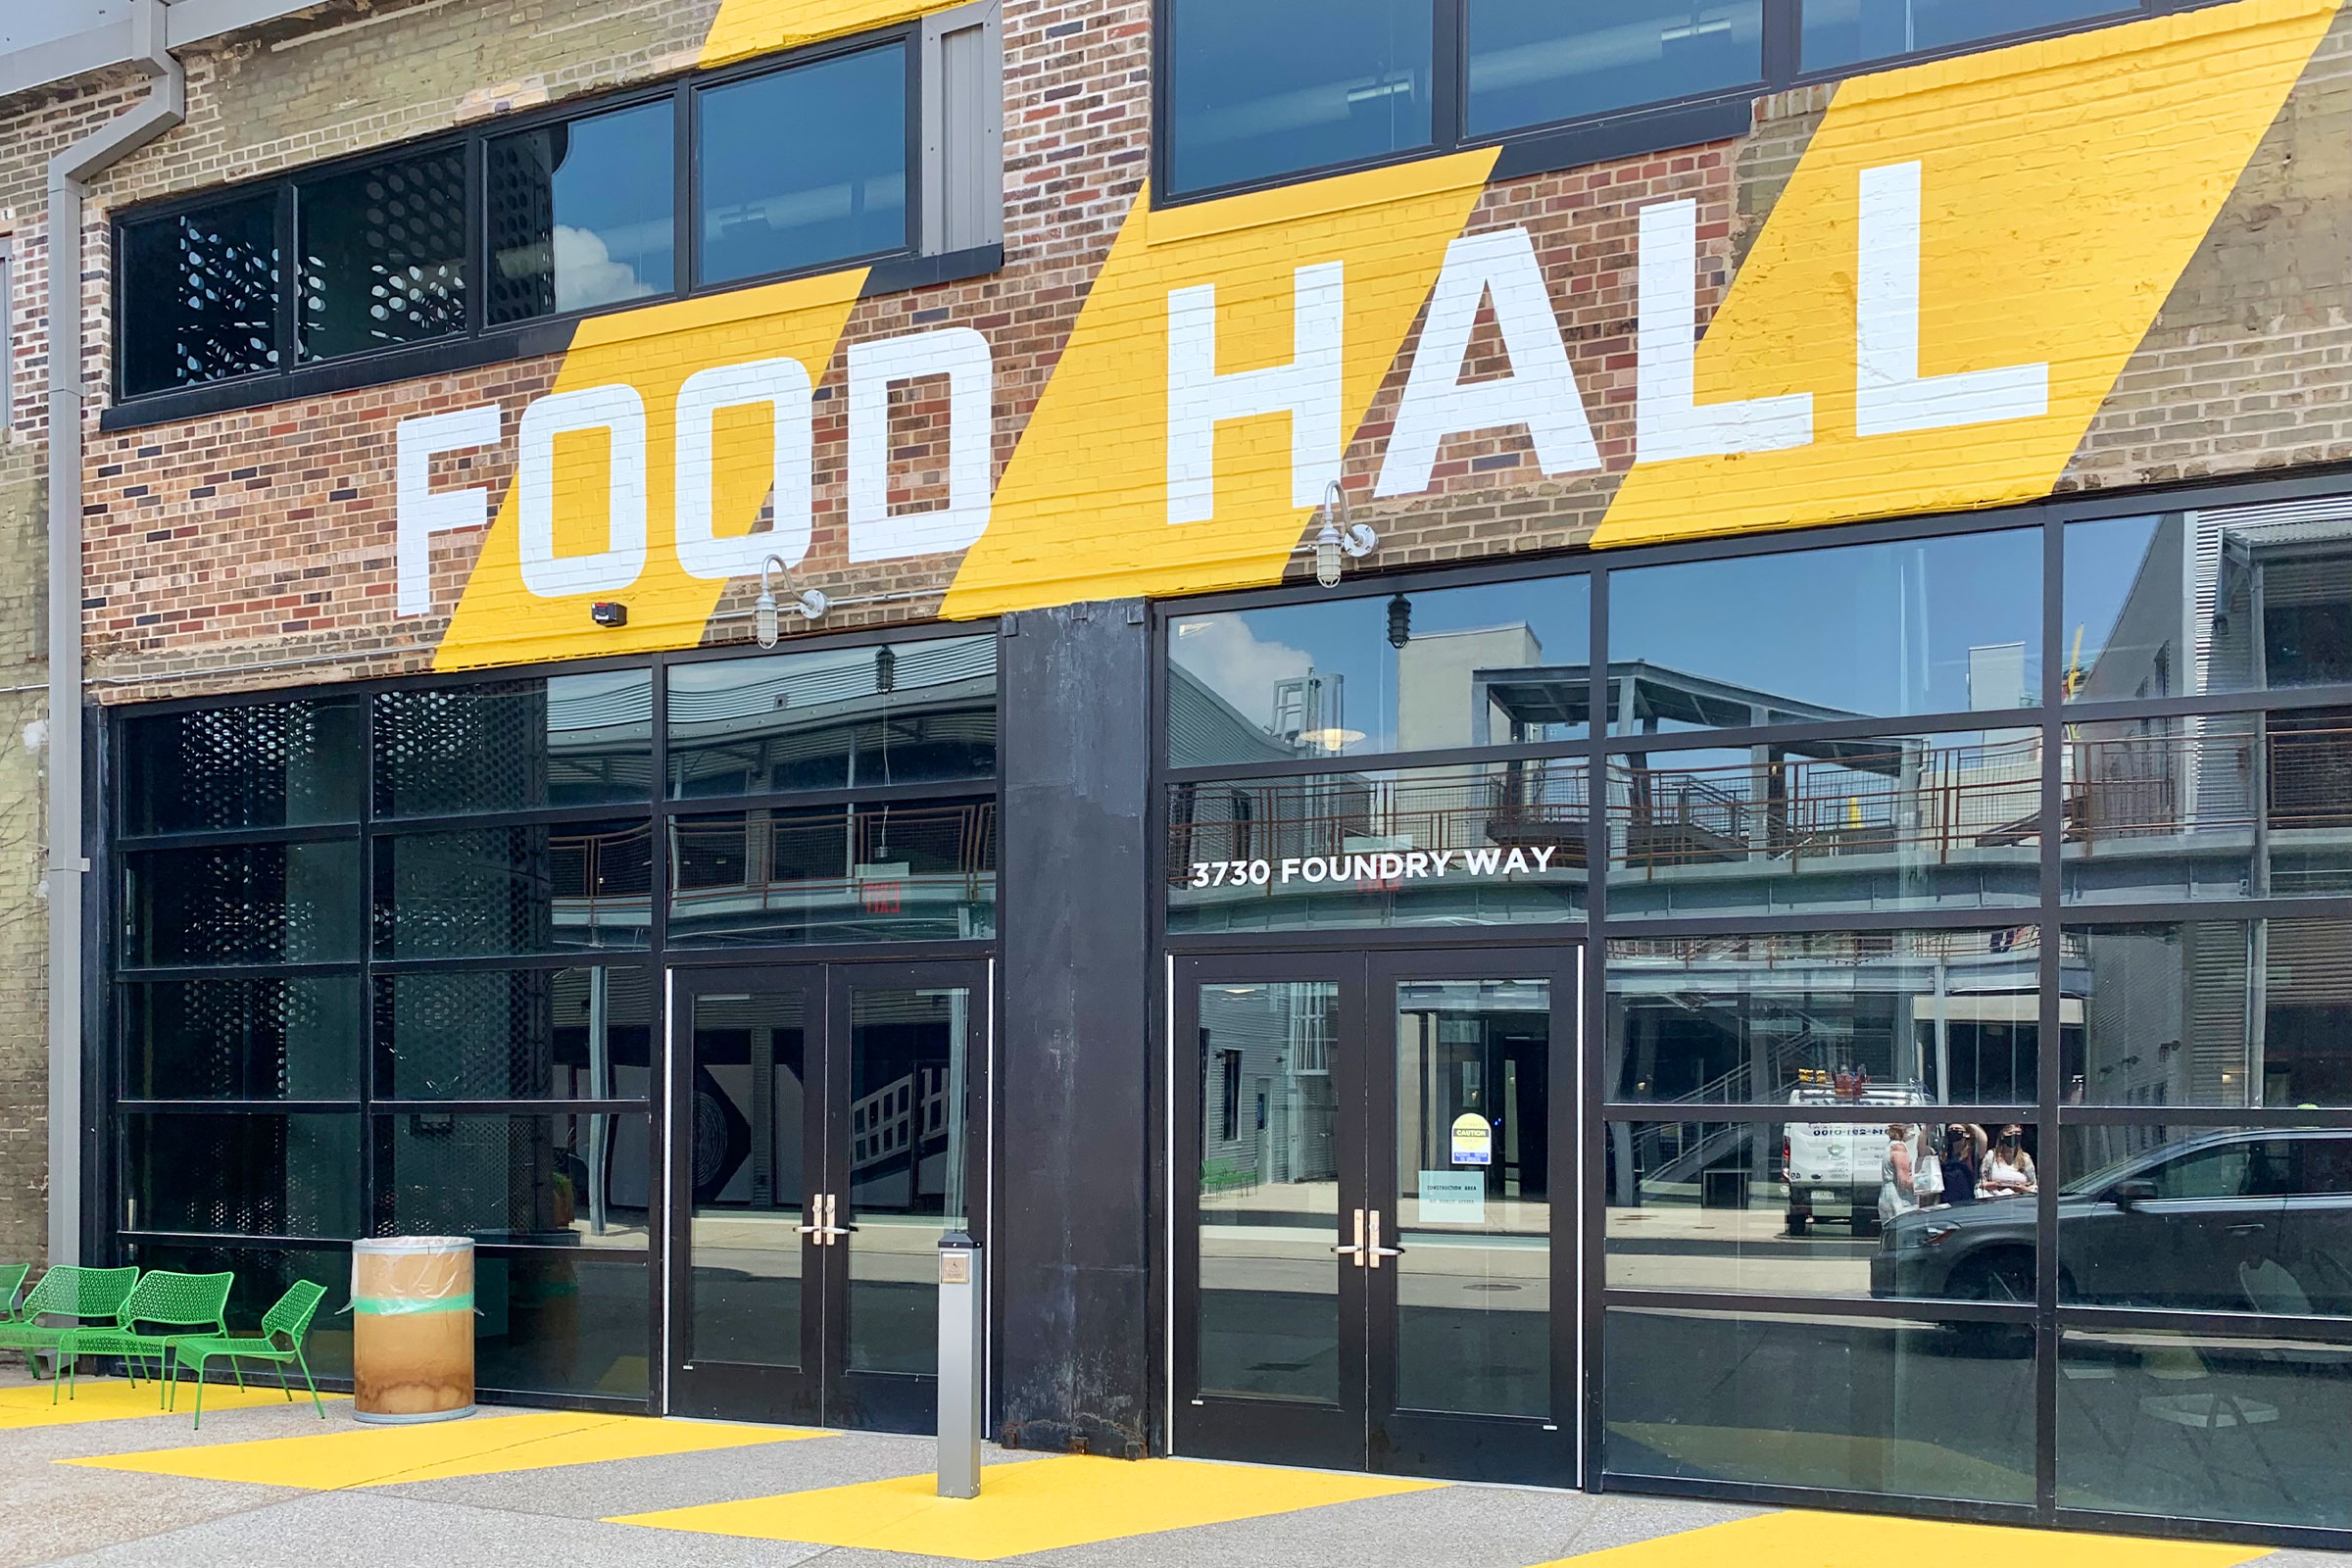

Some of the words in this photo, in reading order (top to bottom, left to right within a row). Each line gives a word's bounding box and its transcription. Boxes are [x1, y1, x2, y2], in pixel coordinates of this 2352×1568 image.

[396, 326, 994, 617] FOOD
[1166, 161, 2049, 525] HALL
[1193, 859, 1270, 888] 3730
[1282, 851, 1453, 884] FOUNDRY
[1464, 846, 1556, 876] WAY
